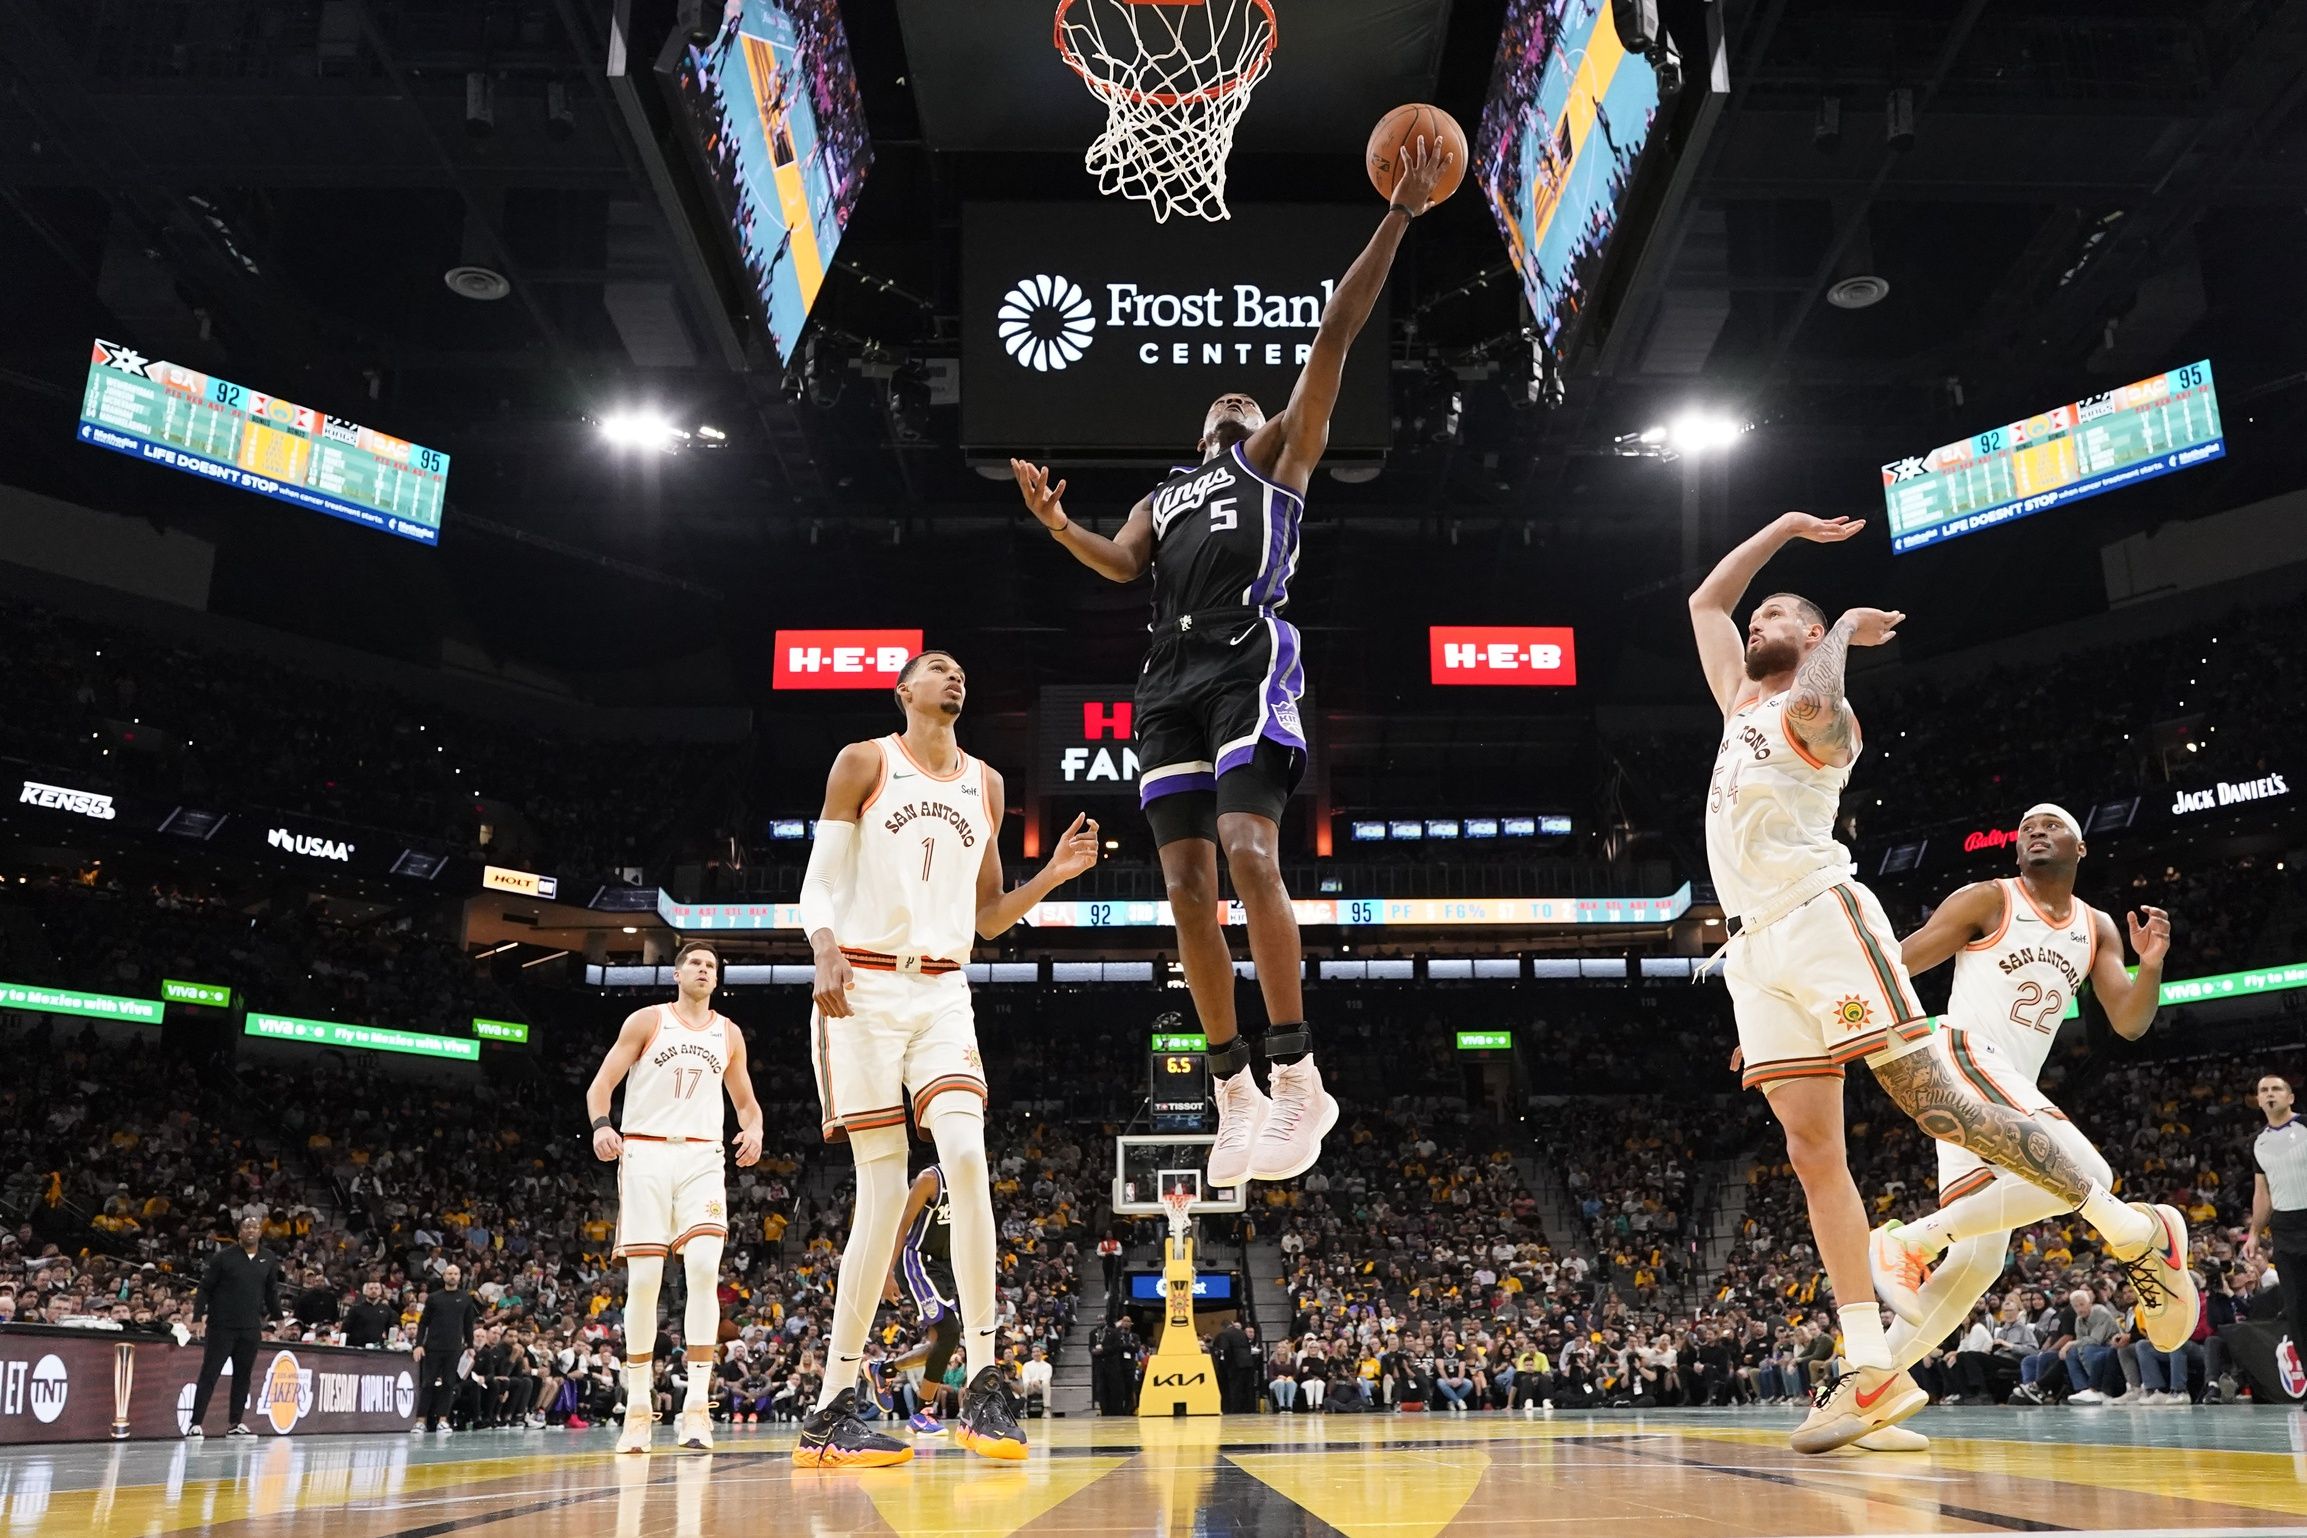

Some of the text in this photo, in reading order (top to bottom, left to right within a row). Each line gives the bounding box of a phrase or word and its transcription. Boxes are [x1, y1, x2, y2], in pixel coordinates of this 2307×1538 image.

[1106, 283, 1224, 328] Frost
[1139, 342, 1313, 365] CENTER
[2179, 365, 2202, 389] 95
[217, 383, 240, 407] 92
[1980, 432, 2000, 453] 92
[421, 449, 440, 472] 95
[144, 443, 175, 464] LIFE
[177, 453, 241, 484] DOESN'T
[241, 474, 278, 493] STOP
[279, 486, 300, 499] when
[324, 500, 361, 517] treatment
[1153, 467, 1236, 541] Kings
[1210, 497, 1238, 533] 5
[1942, 519, 1969, 536] LIFE
[1969, 501, 2024, 528] DOESN'T
[2024, 492, 2058, 512] STOP
[1710, 759, 1742, 814] 54
[2172, 791, 2216, 814] JACK
[885, 801, 975, 848] SAN ANTONIO
[921, 837, 935, 882] 1
[494, 875, 533, 887] HOLT
[1091, 905, 1111, 926] 92
[1352, 902, 1372, 922] 95
[1392, 904, 1412, 918] PF
[1531, 904, 1553, 918] TO
[1999, 947, 2035, 975] SAN
[2267, 972, 2283, 984] to
[9, 989, 26, 1002] to
[27, 991, 82, 1008] Mexico
[83, 998, 117, 1012] with
[118, 1001, 153, 1016] Viva
[2009, 981, 2063, 1035] 22
[334, 1027, 355, 1042] Fly
[356, 1031, 369, 1042] to
[370, 1033, 414, 1048] Mexico
[415, 1037, 442, 1051] with
[443, 1040, 471, 1054] Viva
[654, 1044, 722, 1075] SAN ANTONIO
[1167, 1057, 1191, 1073] 6.5
[673, 1067, 703, 1100] 17
[1168, 1102, 1204, 1111] TISSOT
[5, 1361, 28, 1415] ET
[318, 1373, 359, 1413] TUESDAY
[361, 1375, 383, 1413] 10PM
[384, 1375, 395, 1412] ET
